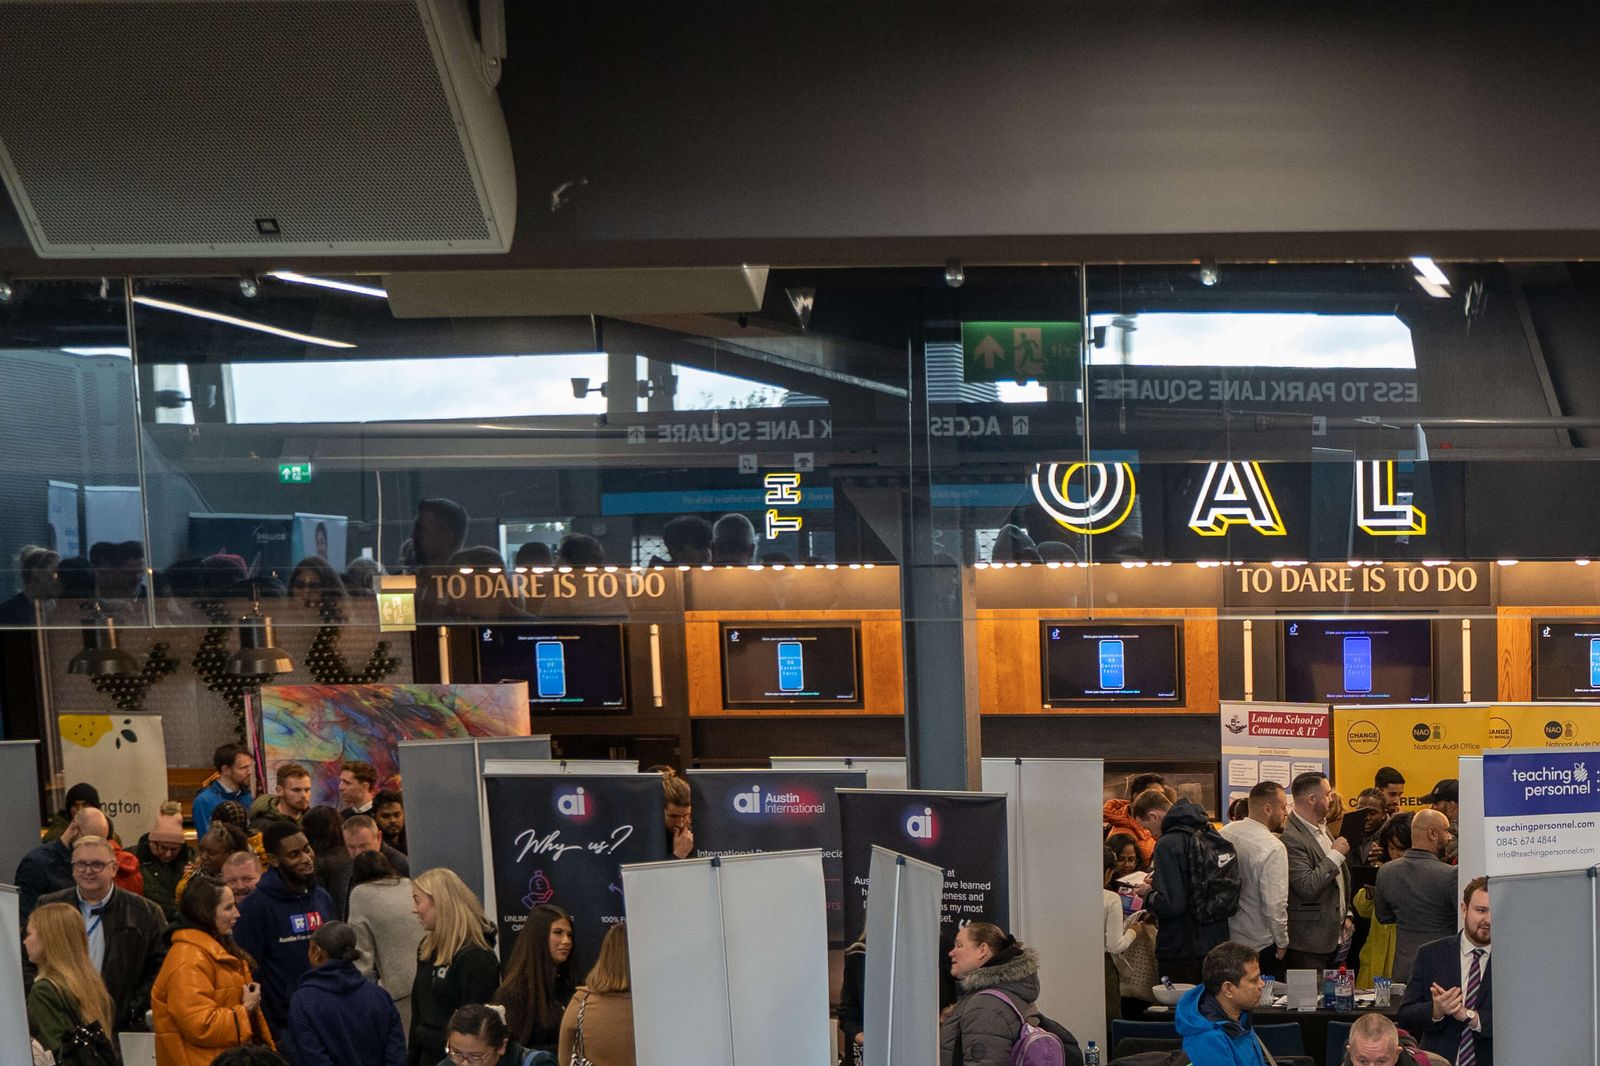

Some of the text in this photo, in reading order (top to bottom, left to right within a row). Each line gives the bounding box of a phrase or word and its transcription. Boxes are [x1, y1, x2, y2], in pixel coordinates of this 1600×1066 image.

[764, 473, 802, 539] TH
[432, 571, 666, 599] TO DARE IS TO DO
[1236, 566, 1478, 593] TO DARE IS TO DO
[1251, 713, 1313, 726] London School
[1251, 725, 1318, 737] Commerce IT
[1512, 766, 1572, 784] teaching
[1525, 781, 1590, 800] personnel
[765, 792, 800, 804] Austin
[100, 799, 141, 818] ngton
[765, 802, 826, 815] International
[1496, 819, 1595, 833] teachingpersonnel.com
[514, 828, 584, 864] Why
[1496, 836, 1557, 846] 0845 674 4844
[1496, 846, 1595, 859] info@teachingpersonnel.com
[960, 880, 991, 891] learned
[968, 891, 985, 902] and
[963, 903, 983, 913] most
